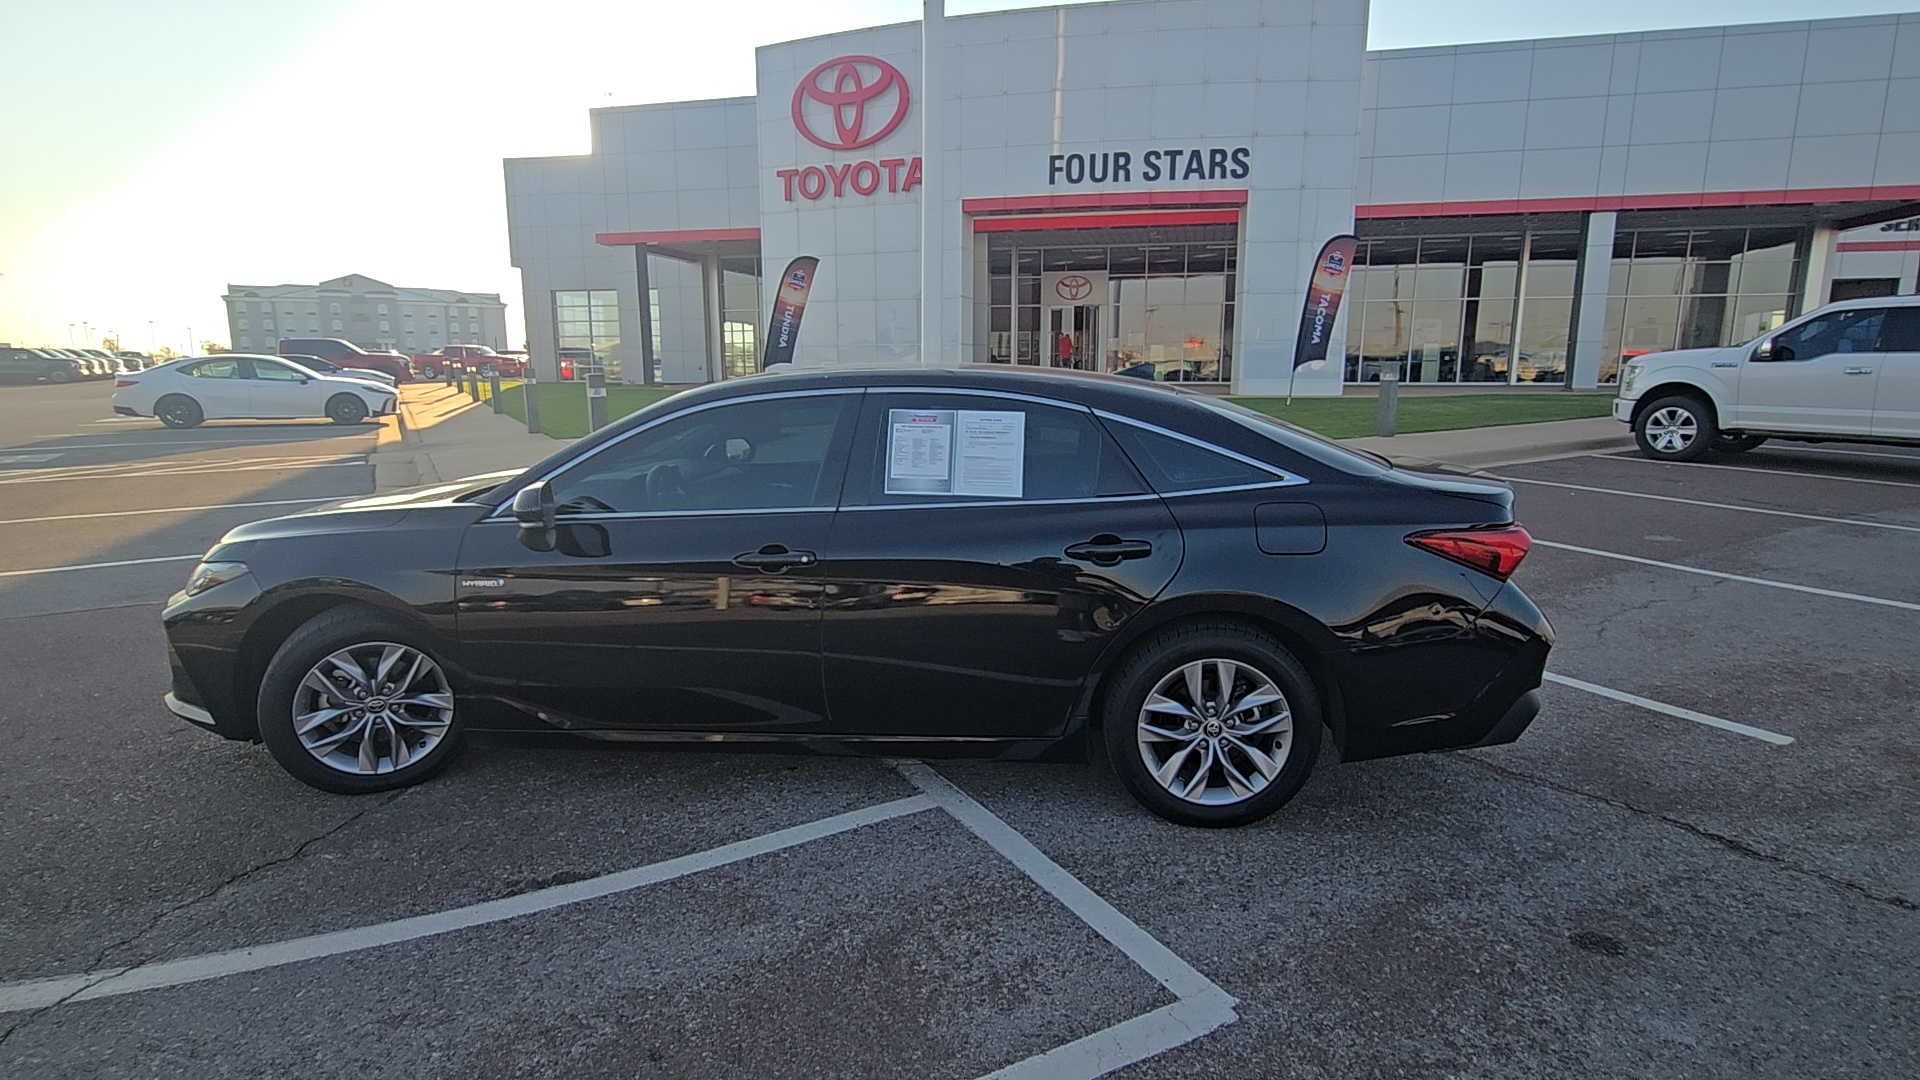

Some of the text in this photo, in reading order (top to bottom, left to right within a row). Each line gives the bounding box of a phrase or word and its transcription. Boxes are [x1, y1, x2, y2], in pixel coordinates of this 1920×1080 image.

[776, 157, 922, 202] TOYOTA
[1049, 147, 1250, 185] FOUR STARS
[778, 305, 795, 348] TUNDRA
[1311, 293, 1332, 345] TACOMA
